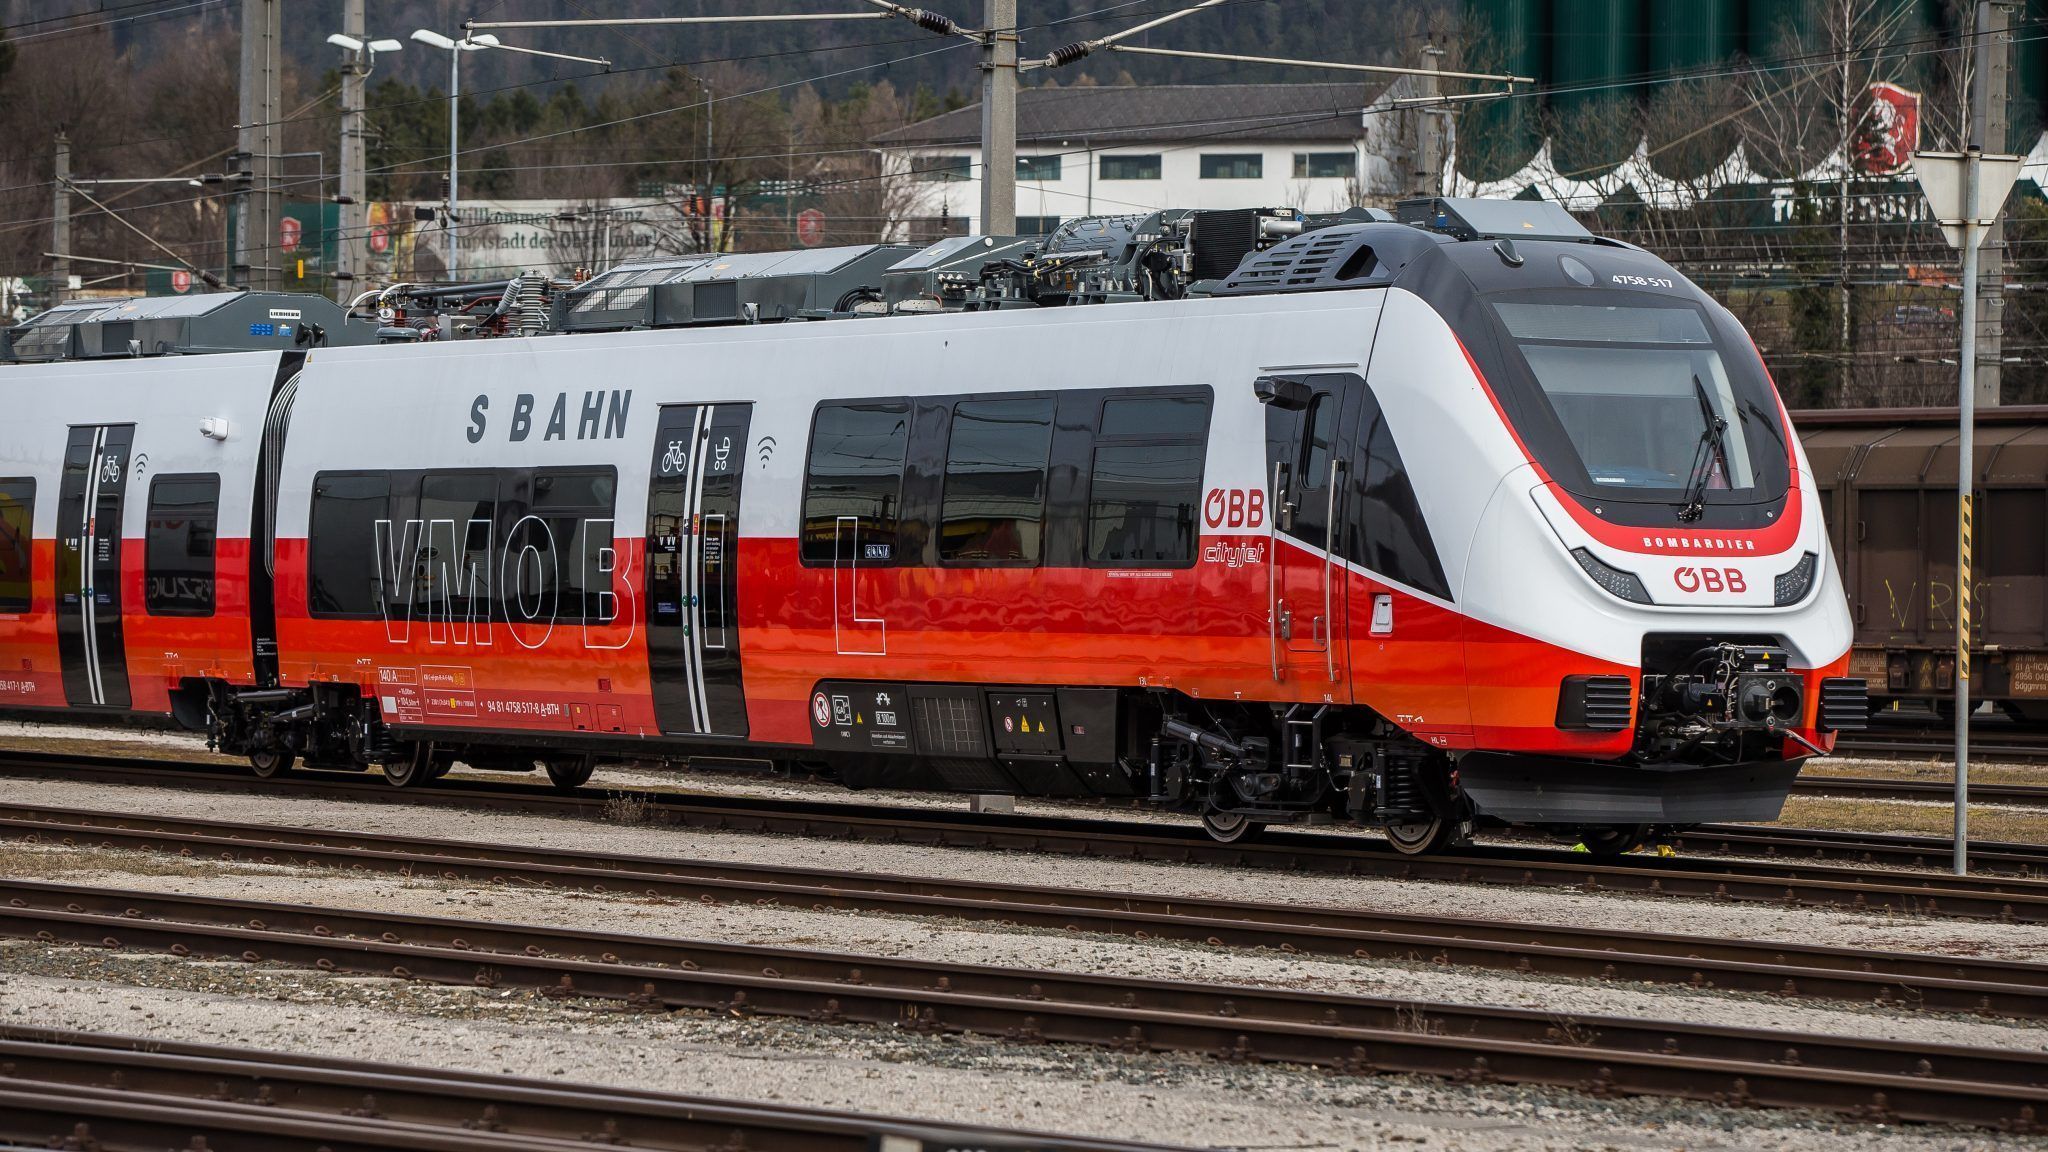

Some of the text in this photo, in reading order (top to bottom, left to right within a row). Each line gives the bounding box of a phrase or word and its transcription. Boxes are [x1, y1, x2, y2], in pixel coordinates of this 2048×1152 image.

[1612, 275, 1673, 288] 4758 517
[466, 389, 633, 444] S BAHN
[1204, 488, 1265, 529] ÖBB
[1203, 542, 1264, 568] cityjet
[1642, 537, 1755, 550] BOMBARDIER
[1673, 566, 1747, 593] ÖBB
[487, 700, 496, 712] 94
[496, 701, 505, 713] 81
[505, 701, 521, 713] 4758
[521, 703, 540, 714] 517-8
[540, 703, 560, 717] A-BTH
